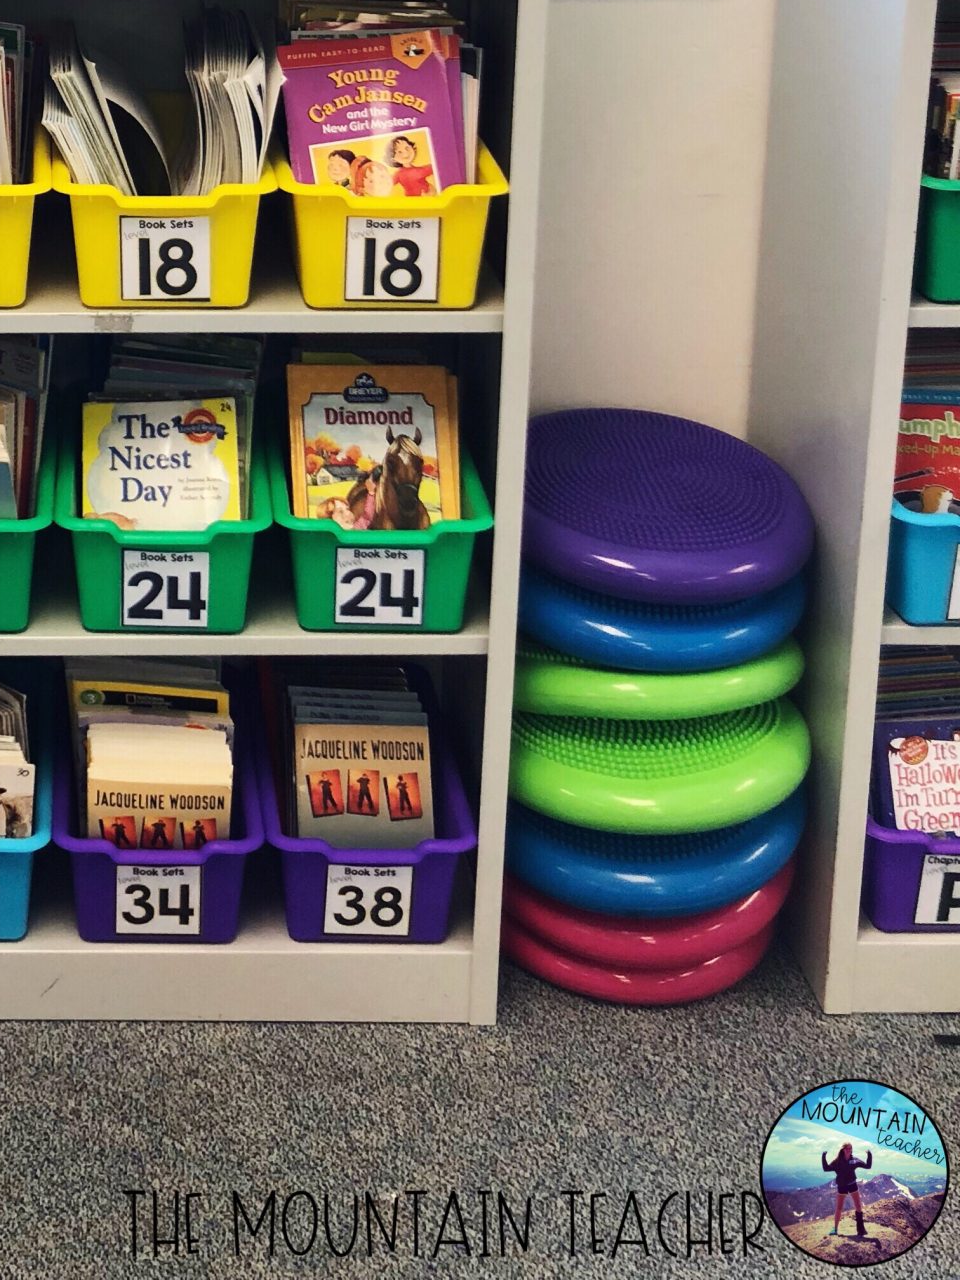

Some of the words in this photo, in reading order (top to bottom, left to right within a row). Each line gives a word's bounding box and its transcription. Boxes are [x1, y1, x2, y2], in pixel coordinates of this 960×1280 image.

[287, 51, 317, 61] PUFFIN
[321, 45, 386, 58] EASY-TO-READ
[328, 68, 400, 88] Young
[308, 94, 355, 123] Cam
[355, 86, 428, 113] Jansen
[346, 107, 368, 120] and
[369, 106, 389, 118] the
[322, 123, 348, 135] New
[349, 120, 370, 132] Girl
[370, 116, 417, 131] Mystery
[139, 220, 166, 230] Book
[170, 219, 194, 229] Sets
[365, 219, 394, 230] Book
[398, 219, 422, 230] Sets
[138, 237, 198, 296] 18
[363, 237, 423, 297] 18
[348, 387, 384, 396] BREYER
[220, 401, 233, 412] 24
[323, 406, 414, 426] Diamond
[117, 414, 170, 440] The
[108, 445, 193, 471] Nicest
[120, 477, 173, 508] Day
[140, 553, 167, 563] Book
[171, 553, 194, 563] Sets
[354, 550, 381, 560] Book
[384, 550, 408, 560] Sets
[127, 571, 206, 620] 24
[340, 568, 419, 618] 24
[87, 693, 97, 704] 3
[300, 738, 368, 760] JACQUELINE
[371, 740, 425, 761] WOODSON
[933, 742, 958, 761] It's
[16, 767, 30, 778] 30
[94, 789, 165, 810] JACQUELINE
[169, 794, 225, 810] WOODSON
[895, 788, 920, 808] I'm
[132, 867, 160, 877] Book
[162, 867, 185, 877] Sets
[344, 867, 372, 877] Book
[373, 868, 397, 878] Sets
[122, 883, 194, 925] 34
[333, 885, 404, 927] 38
